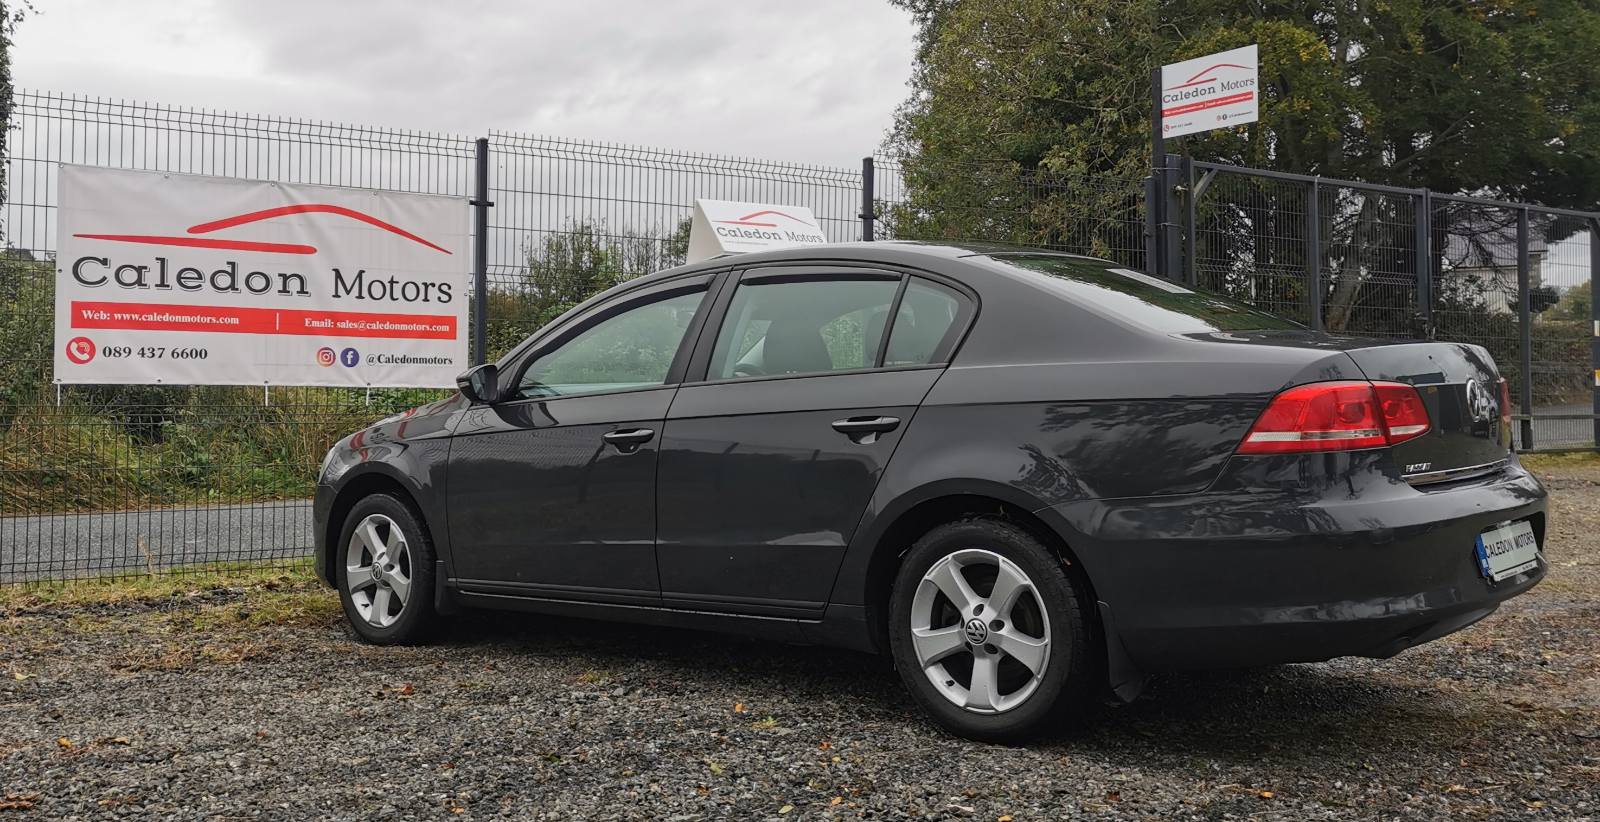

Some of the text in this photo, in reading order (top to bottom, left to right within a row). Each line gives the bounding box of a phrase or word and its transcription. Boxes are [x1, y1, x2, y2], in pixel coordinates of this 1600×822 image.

[1162, 86, 1216, 103] Caledon
[1221, 78, 1255, 92] Motors
[716, 226, 782, 240] Caledon
[784, 231, 823, 243] Motors
[72, 256, 453, 304] Caledon Motors
[81, 309, 239, 325] Web: www.caledonmotors.com
[304, 317, 450, 332] Email: sales@caledonmotors.com
[102, 346, 208, 360] 089 437 6600
[365, 353, 453, 366] @Caledonmotors
[1484, 531, 1535, 558] CALEDON MOTORS
